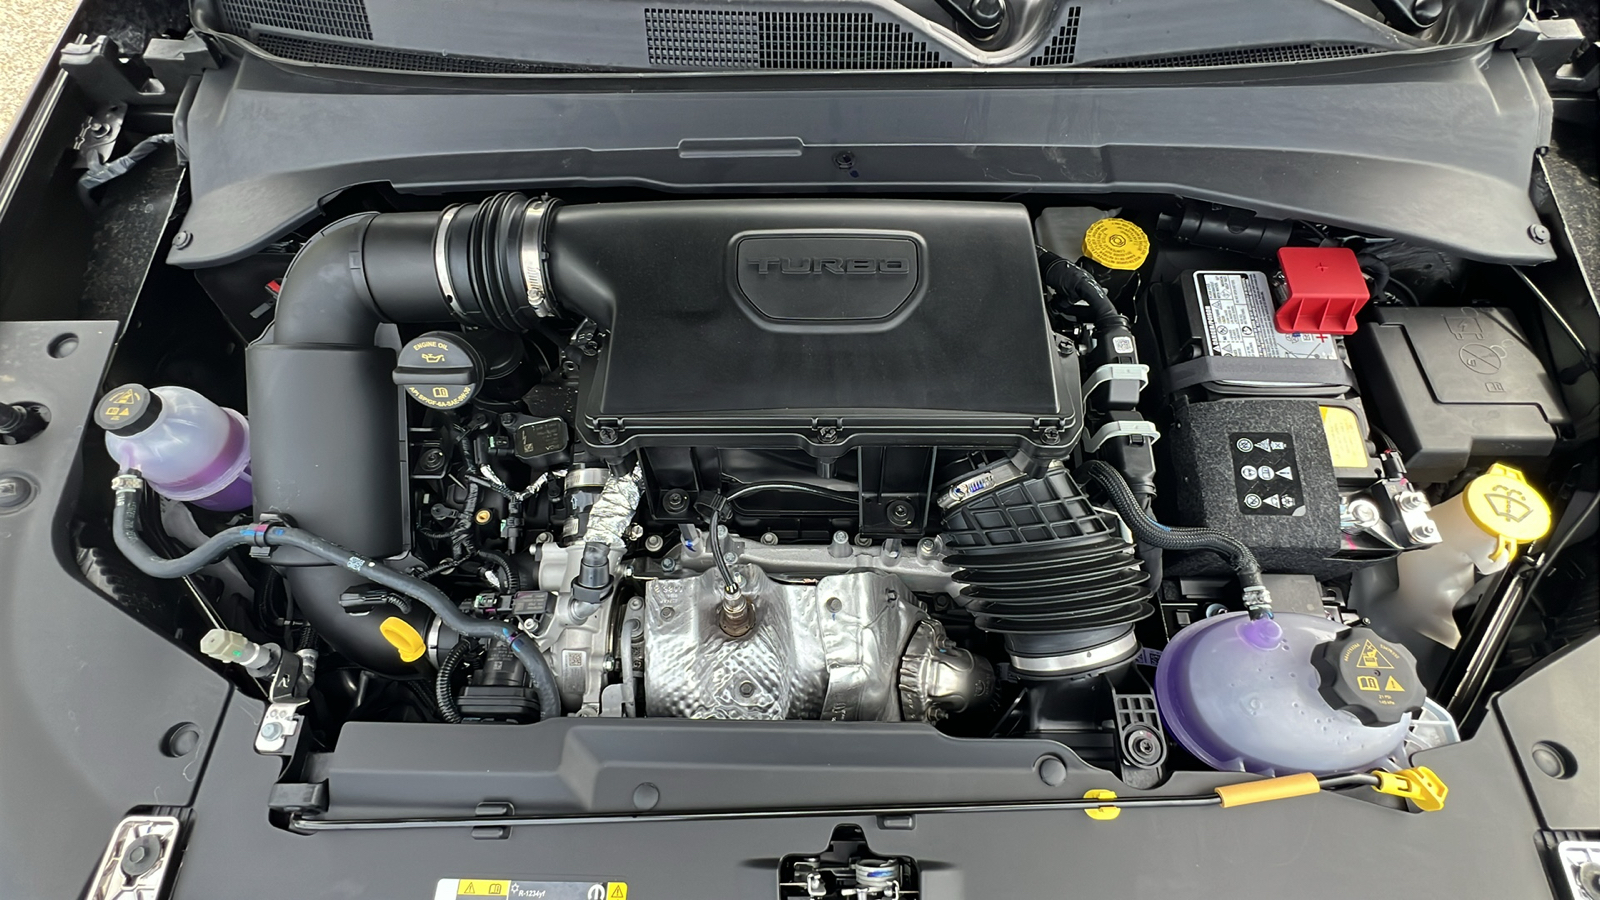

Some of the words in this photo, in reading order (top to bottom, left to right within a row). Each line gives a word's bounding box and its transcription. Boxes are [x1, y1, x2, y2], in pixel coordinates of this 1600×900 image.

[748, 256, 910, 275] TURBO
[413, 341, 437, 351] ENGINE
[437, 342, 449, 351] OIL
[409, 386, 419, 397] API
[518, 890, 546, 899] R-1234yf
